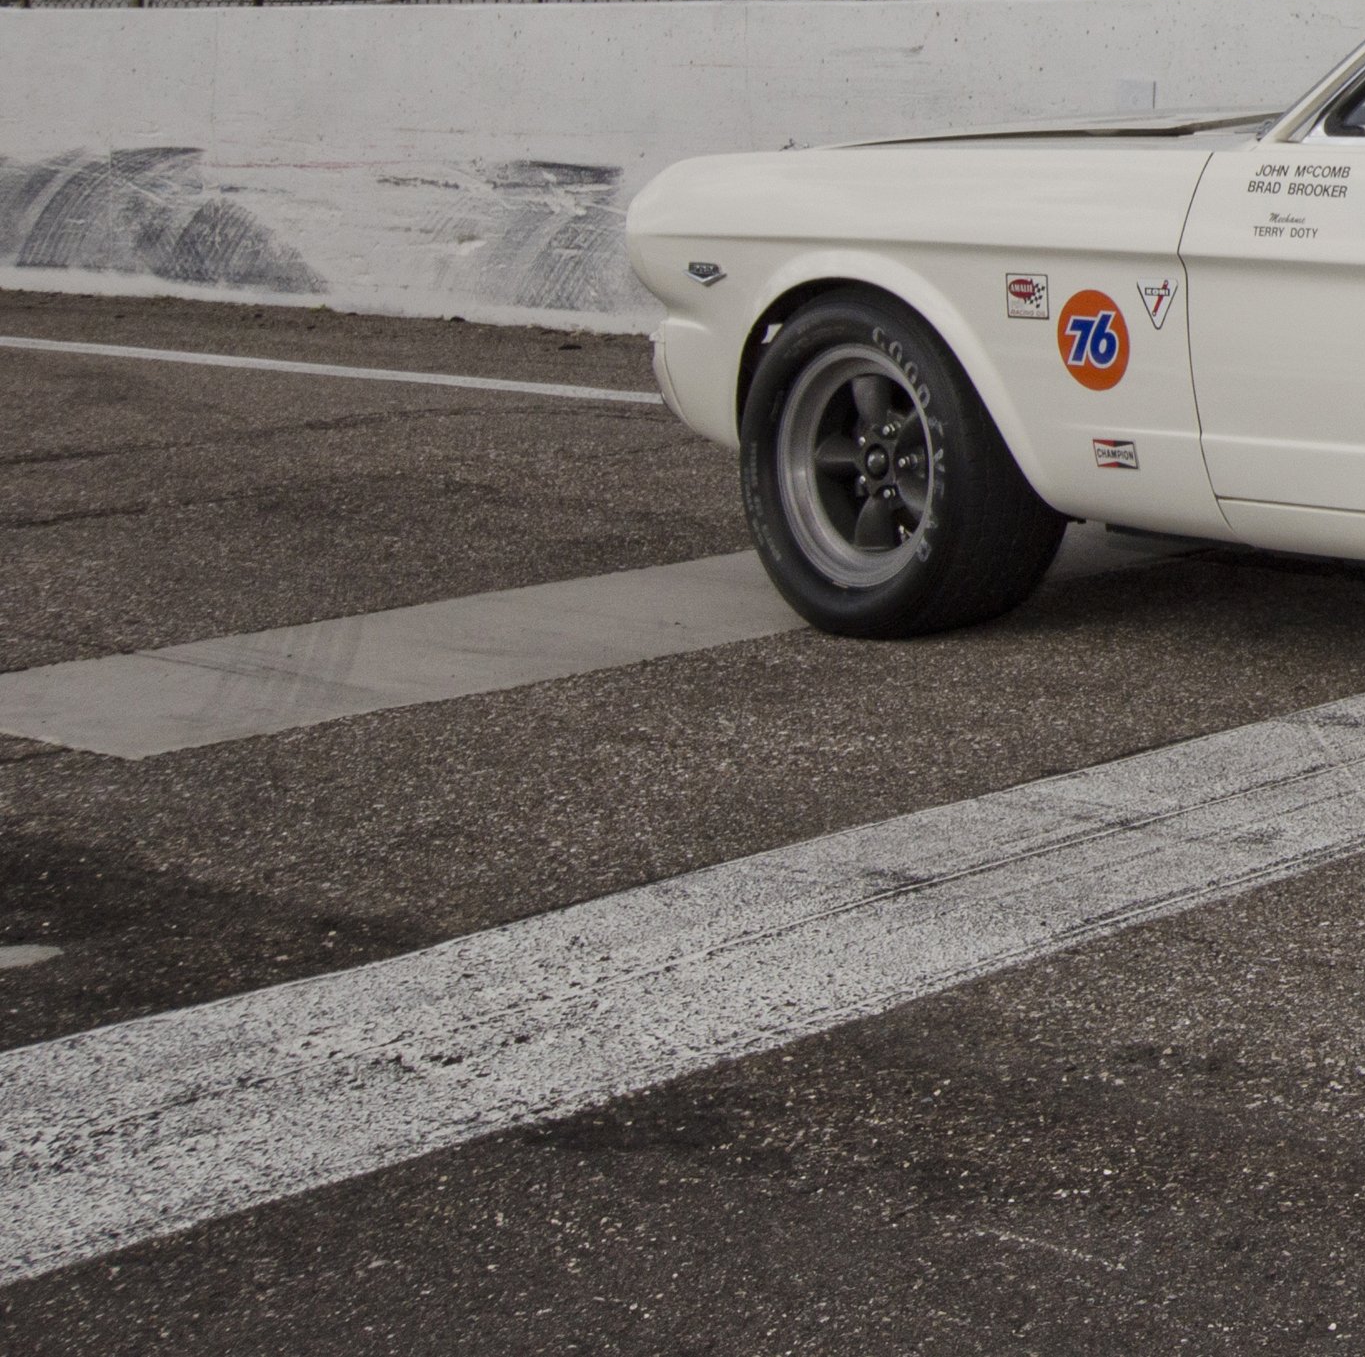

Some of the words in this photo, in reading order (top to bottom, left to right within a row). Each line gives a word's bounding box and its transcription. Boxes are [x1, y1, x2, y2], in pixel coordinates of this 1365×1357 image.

[1255, 164, 1290, 177] JOHN
[1294, 165, 1352, 179] McCOMB
[1247, 180, 1282, 194] BRAD
[1287, 182, 1348, 198] BROOKER
[1253, 226, 1285, 237] TERRY
[1290, 227, 1319, 239] DOTY
[1145, 288, 1170, 296] KONI
[1065, 310, 1119, 369] 76
[1096, 448, 1135, 461] CHAMPION
